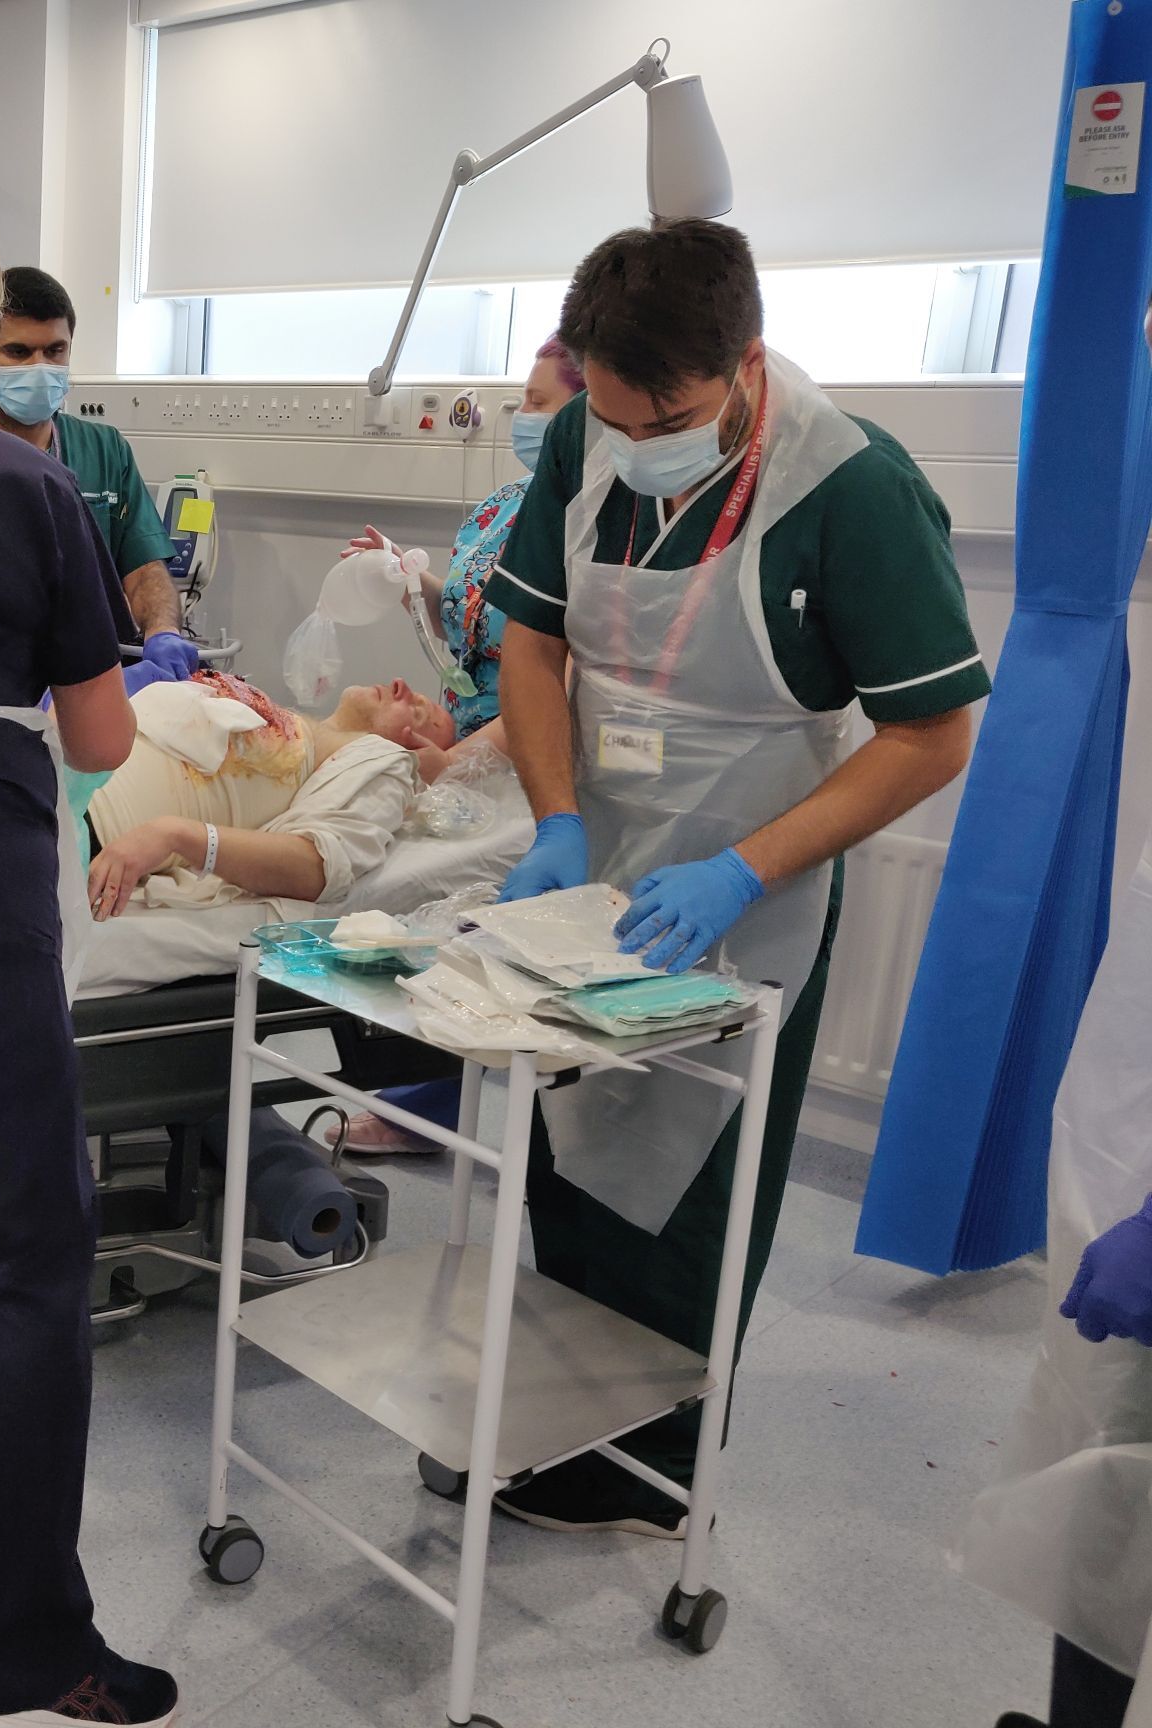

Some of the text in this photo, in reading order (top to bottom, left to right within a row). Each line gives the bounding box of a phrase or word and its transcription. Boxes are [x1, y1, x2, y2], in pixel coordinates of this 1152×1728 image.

[1084, 126, 1111, 134] PLEASE
[1079, 132, 1130, 142] BEFORE ENTRY
[726, 446, 763, 518] SPECIALIST
